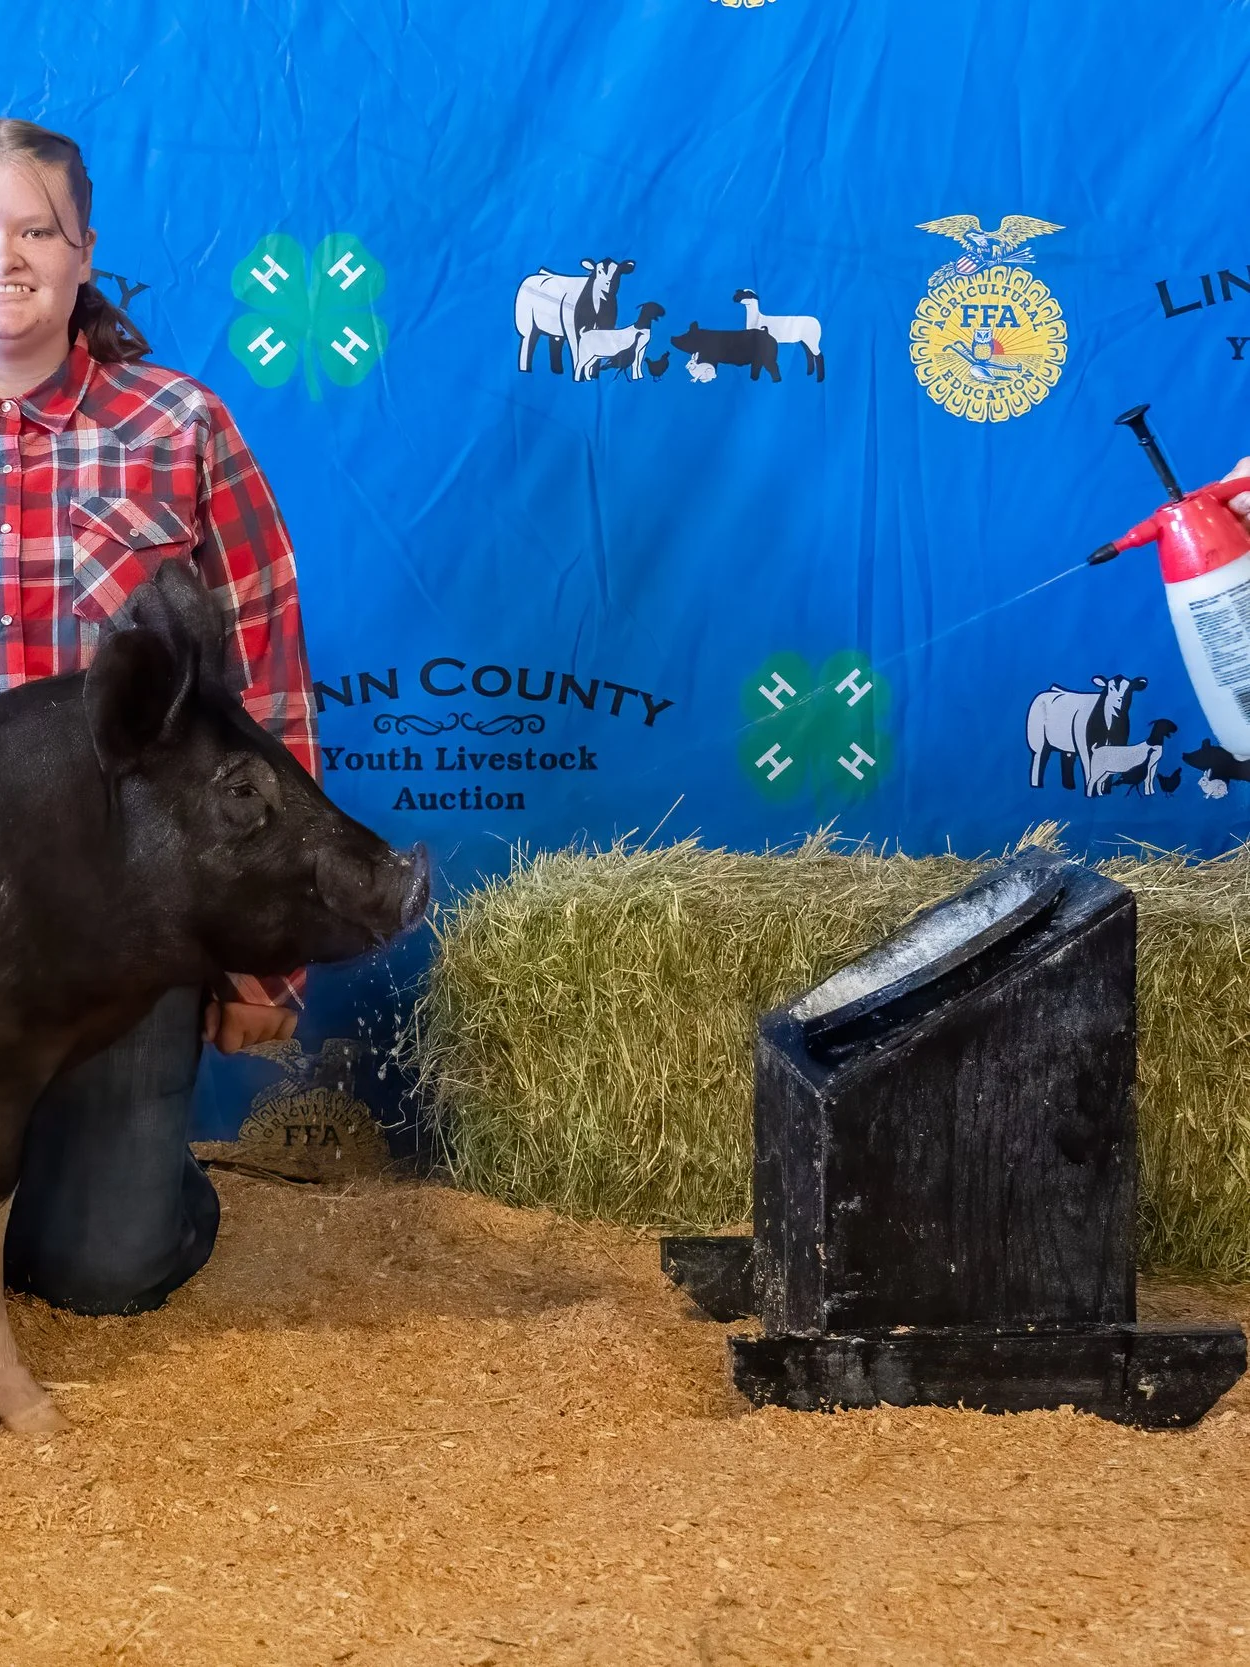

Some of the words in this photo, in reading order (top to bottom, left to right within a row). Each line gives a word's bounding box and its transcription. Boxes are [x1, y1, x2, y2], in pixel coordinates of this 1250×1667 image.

[250, 254, 289, 294] H
[327, 251, 366, 291] H
[1155, 265, 1250, 318] LIN
[934, 284, 1045, 333] AGRICULTURAL
[960, 304, 1021, 329] FFA
[247, 327, 287, 366] H
[330, 326, 370, 366] H
[942, 367, 1035, 401] EDUCATION
[315, 668, 400, 713] NN
[419, 657, 675, 727] COUNTY
[758, 671, 797, 710] H
[834, 668, 873, 707] H
[322, 746, 424, 771] Youth
[436, 746, 598, 771] Livestock
[755, 742, 794, 782] H
[837, 742, 876, 781] H
[392, 786, 526, 811] Auction
[283, 1125, 342, 1147] FFA
